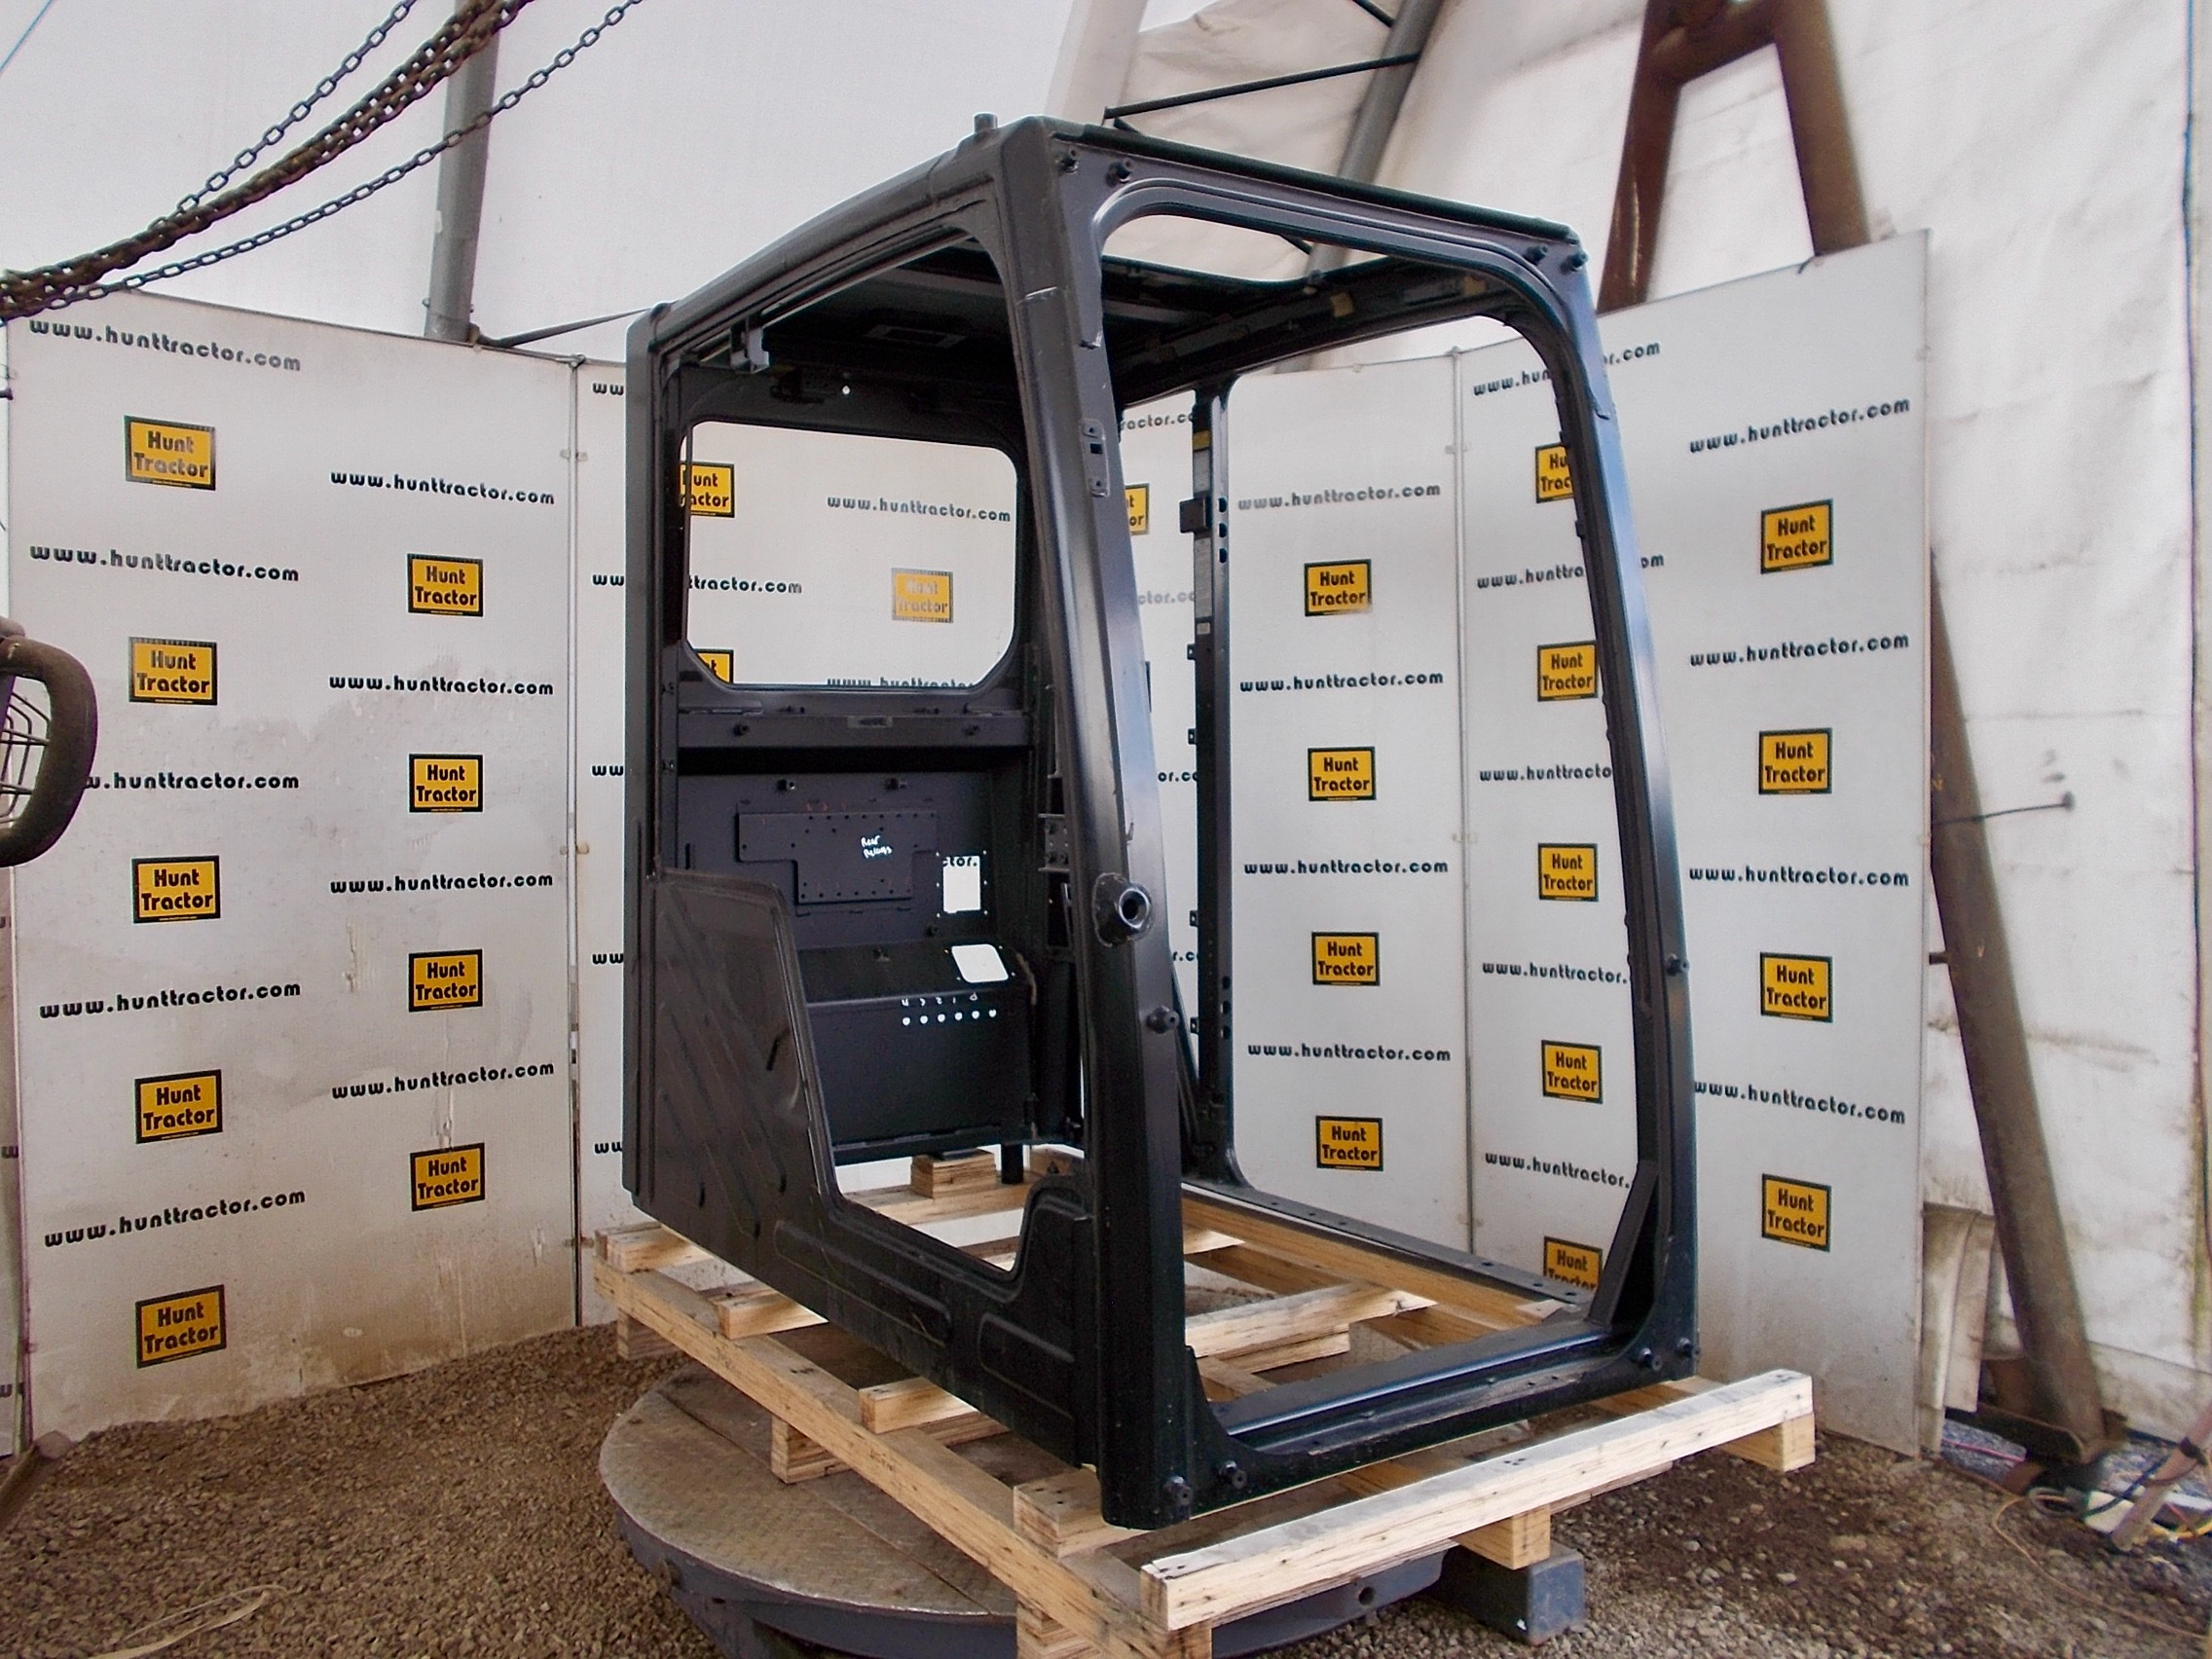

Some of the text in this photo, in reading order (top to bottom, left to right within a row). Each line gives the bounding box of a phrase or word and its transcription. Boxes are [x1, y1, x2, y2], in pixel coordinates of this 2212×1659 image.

[29, 319, 301, 371] www.hunttractor.com
[1690, 397, 1909, 454] www.hunttractor.com
[147, 430, 194, 454] Hunt
[133, 452, 208, 477] Tractor
[331, 471, 554, 504] www.hunttractor.com
[1237, 485, 1440, 511] www.hunttractor.com
[828, 497, 1011, 522] www.hunttractor.com
[1778, 514, 1815, 536] Hunt
[1766, 538, 1826, 561] Tractor
[30, 545, 299, 581] www.hunttractor.com
[425, 566, 465, 585] Hunt
[1320, 571, 1354, 586] Hunt
[415, 585, 477, 606] Tractor
[1310, 590, 1366, 607] Tractor
[151, 649, 197, 670] Hunt
[1690, 633, 1908, 666] www.hunttractor.com
[1551, 652, 1582, 670] Hunt
[136, 672, 209, 693] Tractor
[329, 676, 553, 695] www.hunttractor.com
[1240, 672, 1443, 692] www.hunttractor.com
[1542, 674, 1593, 691] Tractor
[1775, 742, 1813, 759] Hunt
[427, 764, 465, 781] Hunt
[1323, 756, 1358, 771] Hunt
[1314, 776, 1371, 792] Tractor
[1765, 765, 1825, 783] Tractor
[416, 786, 476, 801] Tractor
[1244, 859, 1448, 874] www.hunttractor.com
[1552, 853, 1582, 869] Hunt
[154, 868, 200, 887] Hunt
[330, 873, 553, 893] www.hunttractor.com
[1543, 874, 1593, 891] Tractor
[1690, 866, 1908, 886] www.hunttractor.com
[141, 892, 213, 910] Tractor
[1327, 941, 1362, 957] Hunt
[427, 961, 465, 978] Hunt
[1317, 960, 1374, 977] Tractor
[1777, 964, 1814, 985] Hunt
[40, 982, 301, 1018] www.hunttractor.com
[416, 981, 476, 1000] Tractor
[1766, 987, 1826, 1010] Tractor
[1248, 1043, 1451, 1061] www.hunttractor.com
[1556, 1051, 1587, 1070] Hunt
[332, 1062, 554, 1099] www.hunttractor.com
[1547, 1071, 1597, 1092] Tractor
[156, 1084, 201, 1105] Hunt
[143, 1108, 214, 1130] Tractor
[1332, 1125, 1366, 1141] Hunt
[1322, 1144, 1378, 1161] Tractor
[428, 1157, 466, 1177] Hunt
[418, 1177, 479, 1199] Tractor
[1778, 1188, 1813, 1212] Hunt
[45, 1191, 305, 1247] www.hunttractor.com
[1768, 1209, 1825, 1237] Tractor
[1557, 1249, 1588, 1270] Hunt
[157, 1302, 204, 1327] Hunt
[144, 1324, 218, 1354] Tractor
